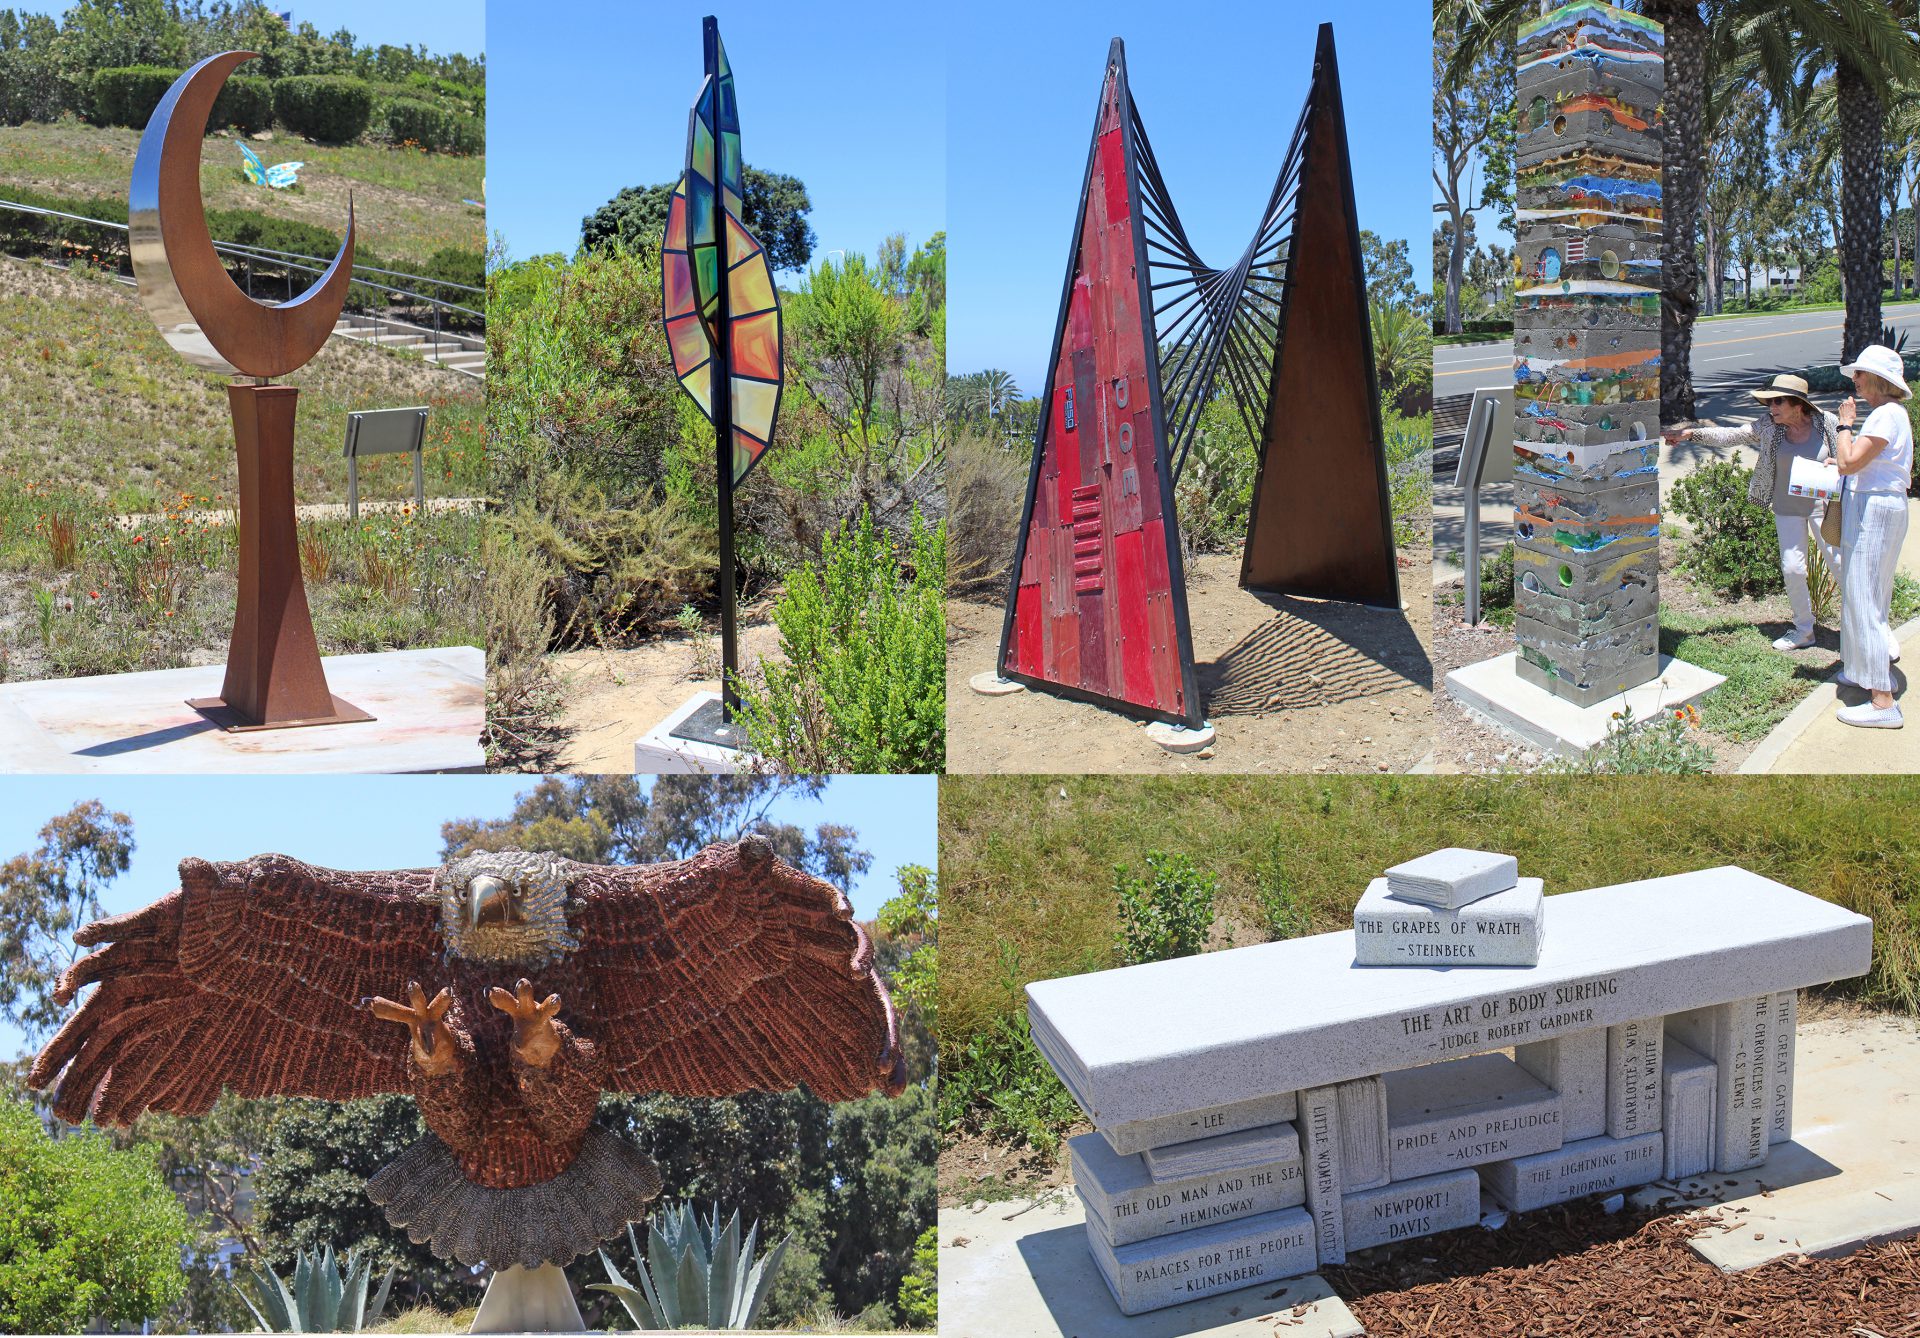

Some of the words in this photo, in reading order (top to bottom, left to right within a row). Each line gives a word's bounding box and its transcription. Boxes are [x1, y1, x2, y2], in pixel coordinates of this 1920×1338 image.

[1359, 921, 1383, 934] THE
[1392, 921, 1440, 934] GRAPES
[1451, 921, 1466, 934] OF
[1477, 922, 1521, 935] WRATH
[1401, 1014, 1432, 1035] THE
[1443, 1005, 1472, 1027] ART
[1482, 1000, 1500, 1019] OF
[1509, 991, 1548, 1014] BODY
[1556, 978, 1618, 1005] SURFING
[1487, 1020, 1531, 1041] ROBERT
[1540, 1008, 1594, 1030] GARDNER
[1756, 994, 1768, 1017] THE
[1779, 999, 1790, 1025] THE
[1627, 1023, 1638, 1049] WEB
[1777, 1034, 1788, 1075] GREAT
[1645, 1040, 1657, 1076] WHITE
[1752, 1023, 1766, 1092] CHRONICLES
[1624, 1056, 1637, 1131] CHARLOTTE'S
[1734, 1076, 1745, 1109] LEWIS
[1751, 1098, 1762, 1110] OF
[1774, 1084, 1787, 1132] GATSBY
[1313, 1106, 1329, 1145] LITTLE
[1397, 1132, 1439, 1151] PRIDE
[1448, 1125, 1477, 1142] AND
[1486, 1110, 1560, 1134] PREJUDICE
[1749, 1117, 1762, 1160] NARNIA
[1317, 1150, 1332, 1194] WOMEN
[1531, 1169, 1552, 1183] THE
[1560, 1154, 1617, 1177] LIGHTNING
[1624, 1146, 1654, 1161] THIEF
[1114, 1202, 1139, 1218] THE
[1147, 1194, 1171, 1210] OLD
[1181, 1187, 1208, 1203] MAN
[1217, 1179, 1243, 1195] AND
[1250, 1171, 1273, 1187] THE
[1281, 1166, 1303, 1181] SEA
[1321, 1210, 1337, 1251] ALCOTT
[1136, 1259, 1190, 1283] PALACES
[1198, 1254, 1222, 1269] FOR
[1228, 1246, 1252, 1262] THE
[1260, 1235, 1305, 1256] PEOPLE
